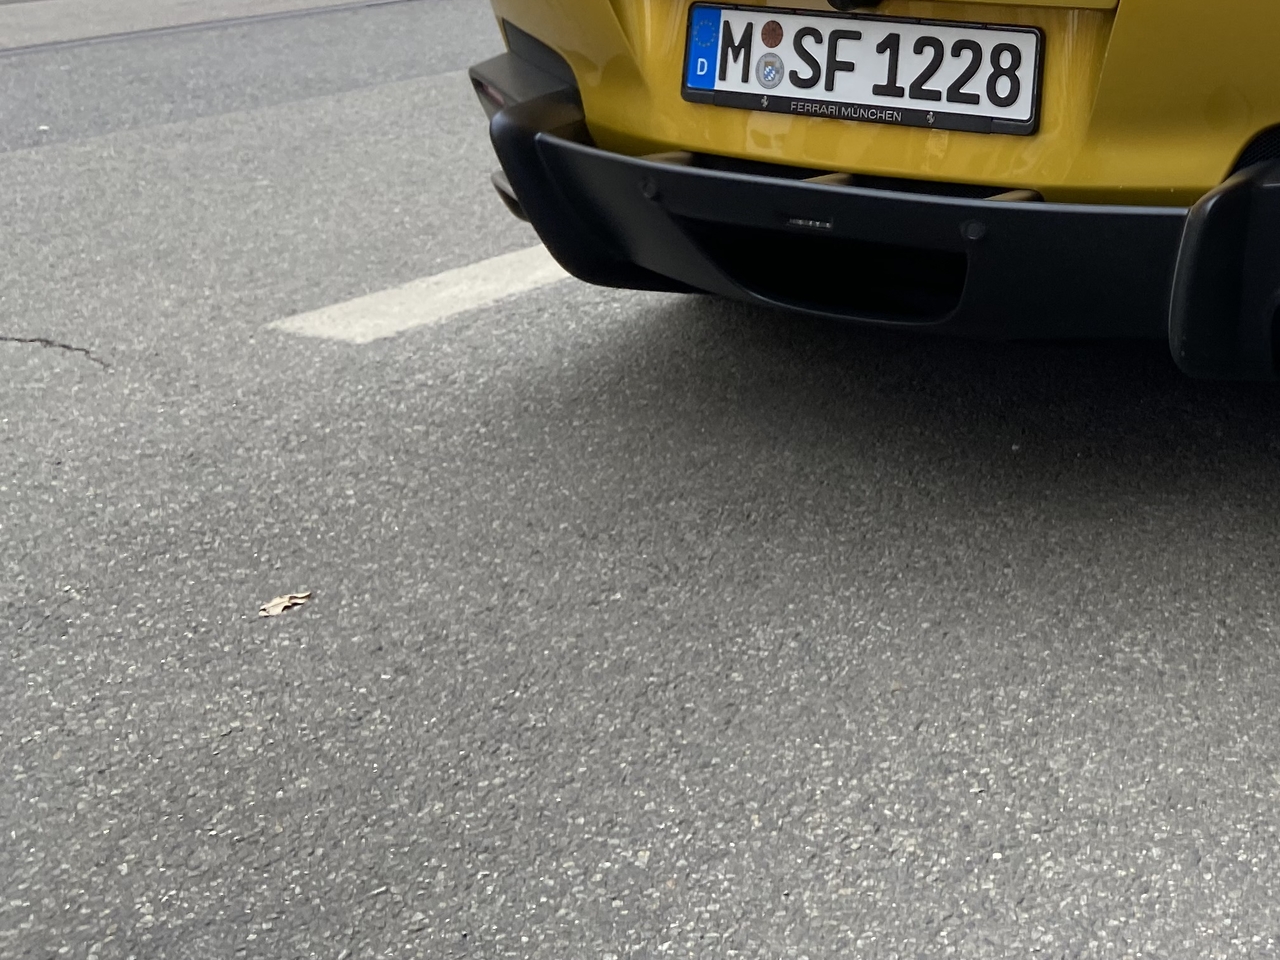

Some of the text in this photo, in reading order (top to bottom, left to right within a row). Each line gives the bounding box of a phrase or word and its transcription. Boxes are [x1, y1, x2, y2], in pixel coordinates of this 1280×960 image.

[696, 57, 708, 75] D
[718, 20, 753, 83] M
[789, 26, 863, 92] SF
[872, 33, 1022, 108] 1228
[790, 101, 902, 122] FERRARI MÜNCHEN
